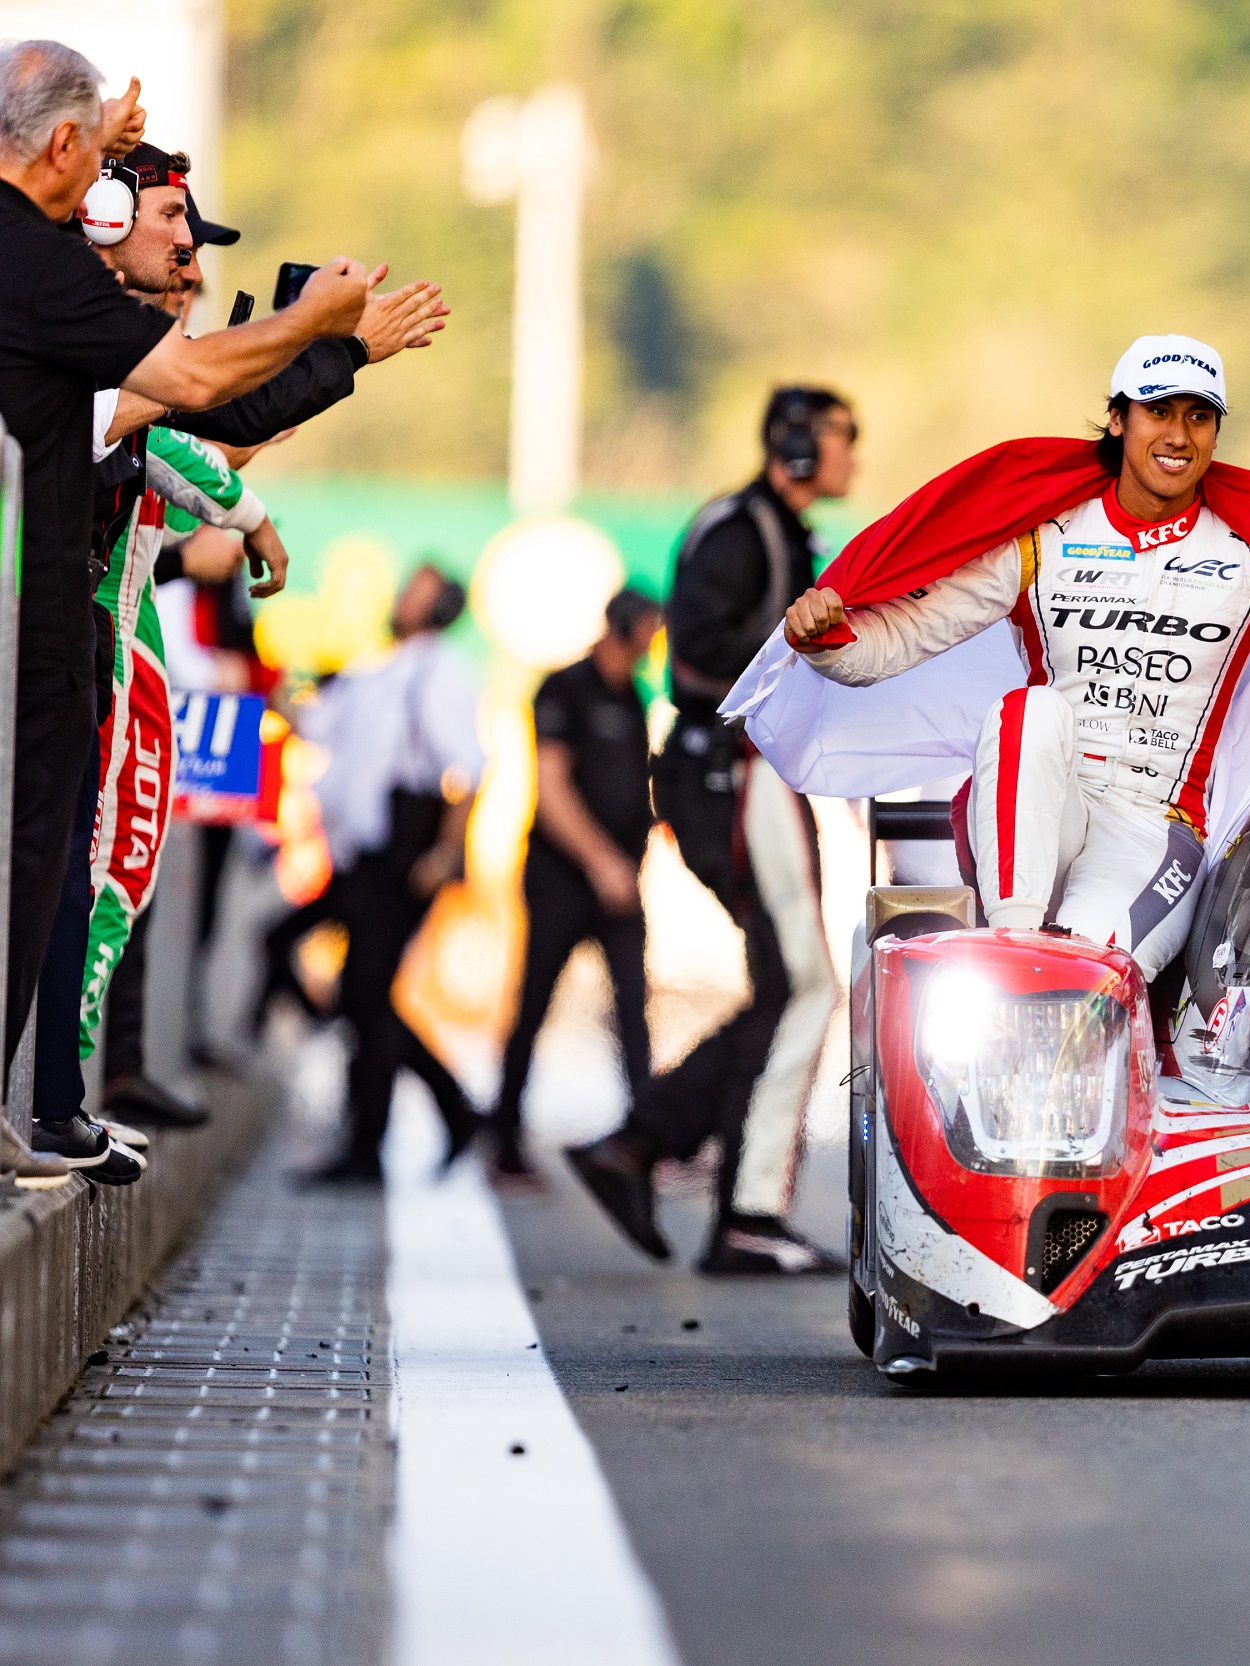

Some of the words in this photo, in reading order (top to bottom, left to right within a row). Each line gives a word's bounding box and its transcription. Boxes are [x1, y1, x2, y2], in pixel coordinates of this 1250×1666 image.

[1143, 354, 1217, 378] GOODYEAR
[1137, 517, 1189, 549] KFC
[1068, 546, 1131, 559] GOODYEAR
[1074, 570, 1139, 586] WRT
[1164, 556, 1241, 581] WEC
[1051, 593, 1137, 605] PERTAMAX
[1050, 607, 1231, 643] TURBO
[1077, 646, 1192, 683] PASEO
[1115, 688, 1169, 718] BNI
[1151, 728, 1179, 741] TACO
[1151, 738, 1177, 750] BELL
[123, 718, 160, 871] JOTA
[1152, 858, 1192, 905] KFC
[1163, 1214, 1245, 1236] TACO
[1115, 1239, 1250, 1275] PERTAMAX
